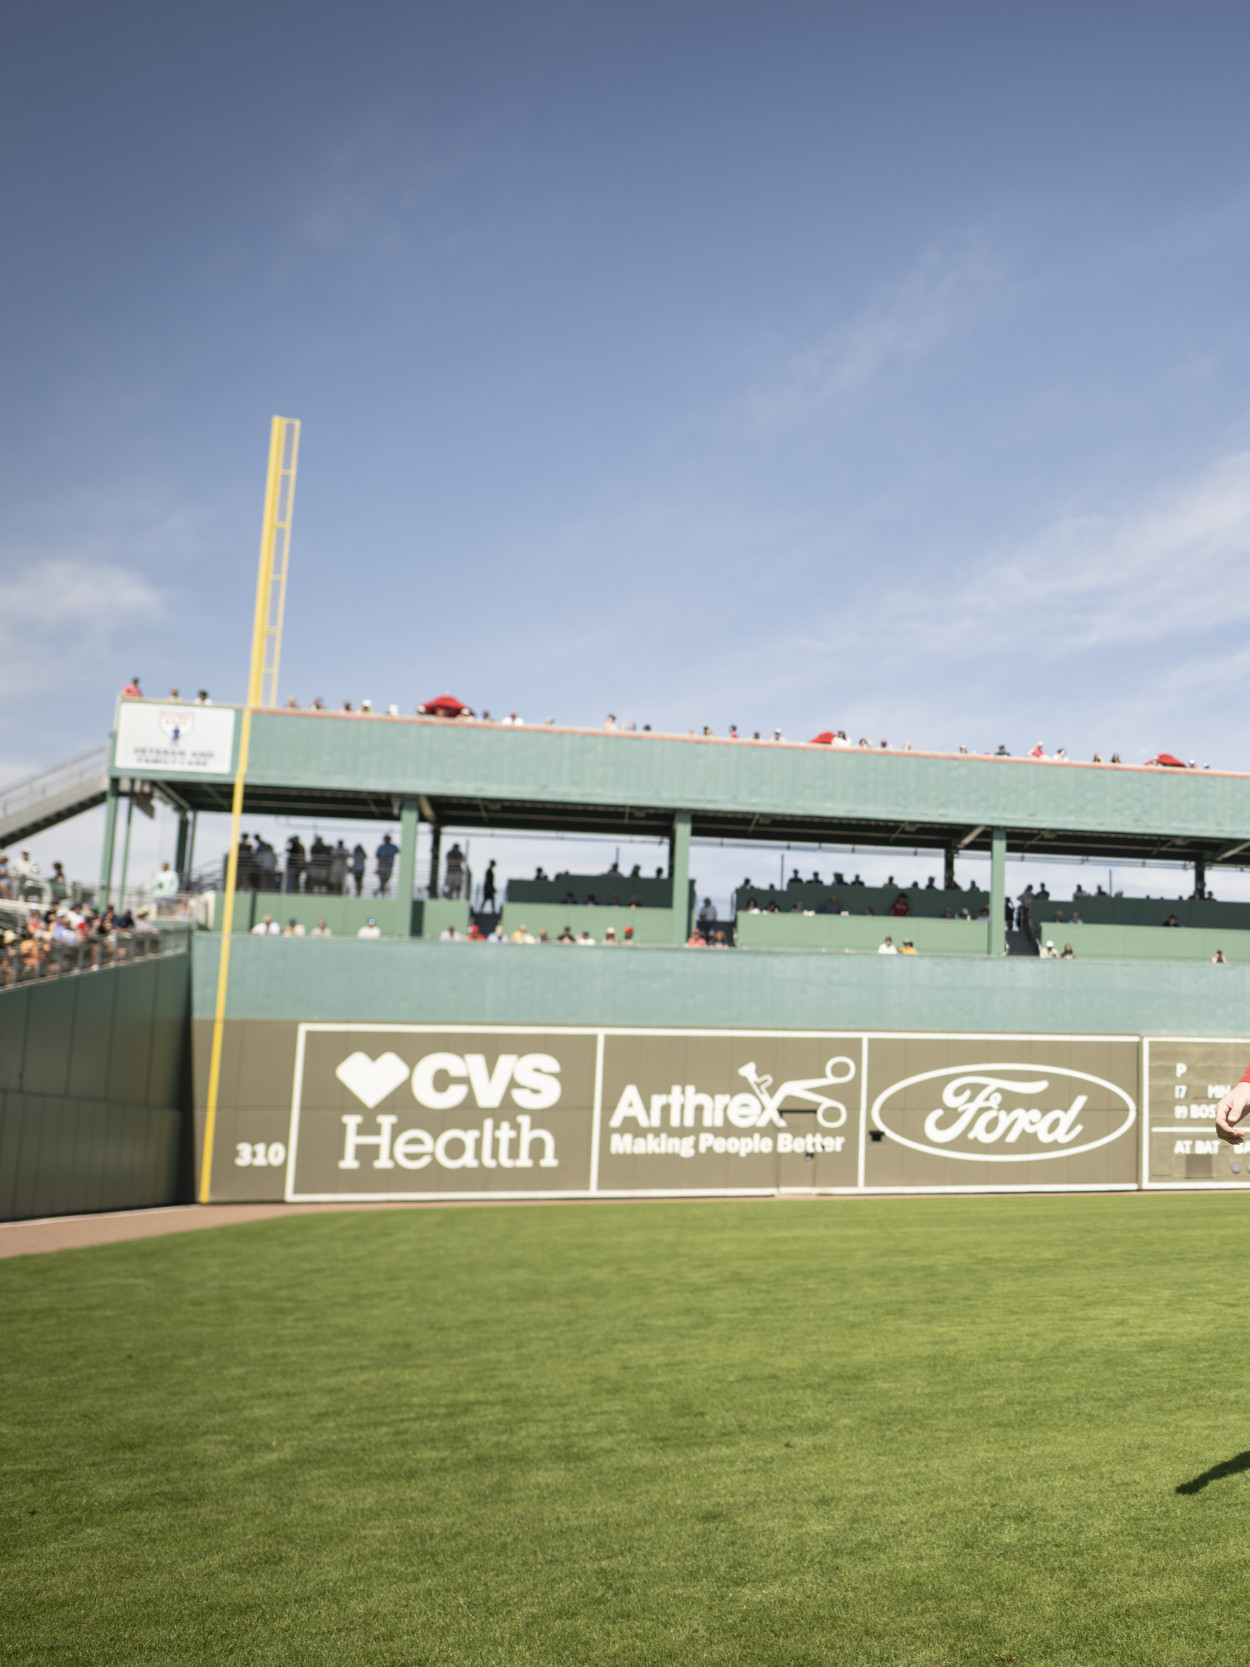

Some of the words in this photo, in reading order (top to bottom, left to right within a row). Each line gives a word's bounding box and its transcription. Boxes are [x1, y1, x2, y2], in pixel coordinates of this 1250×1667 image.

[411, 1052, 562, 1110] CVS
[1175, 1062, 1188, 1078] P
[609, 1083, 787, 1128] Arthrex
[924, 1075, 1088, 1144] Ford
[234, 1142, 286, 1167] 310
[338, 1114, 559, 1170] Health
[610, 1133, 695, 1158] Making
[698, 1133, 774, 1158] People
[777, 1133, 845, 1153] Better
[1174, 1140, 1192, 1155] AT
[1194, 1140, 1221, 1155] BAT
